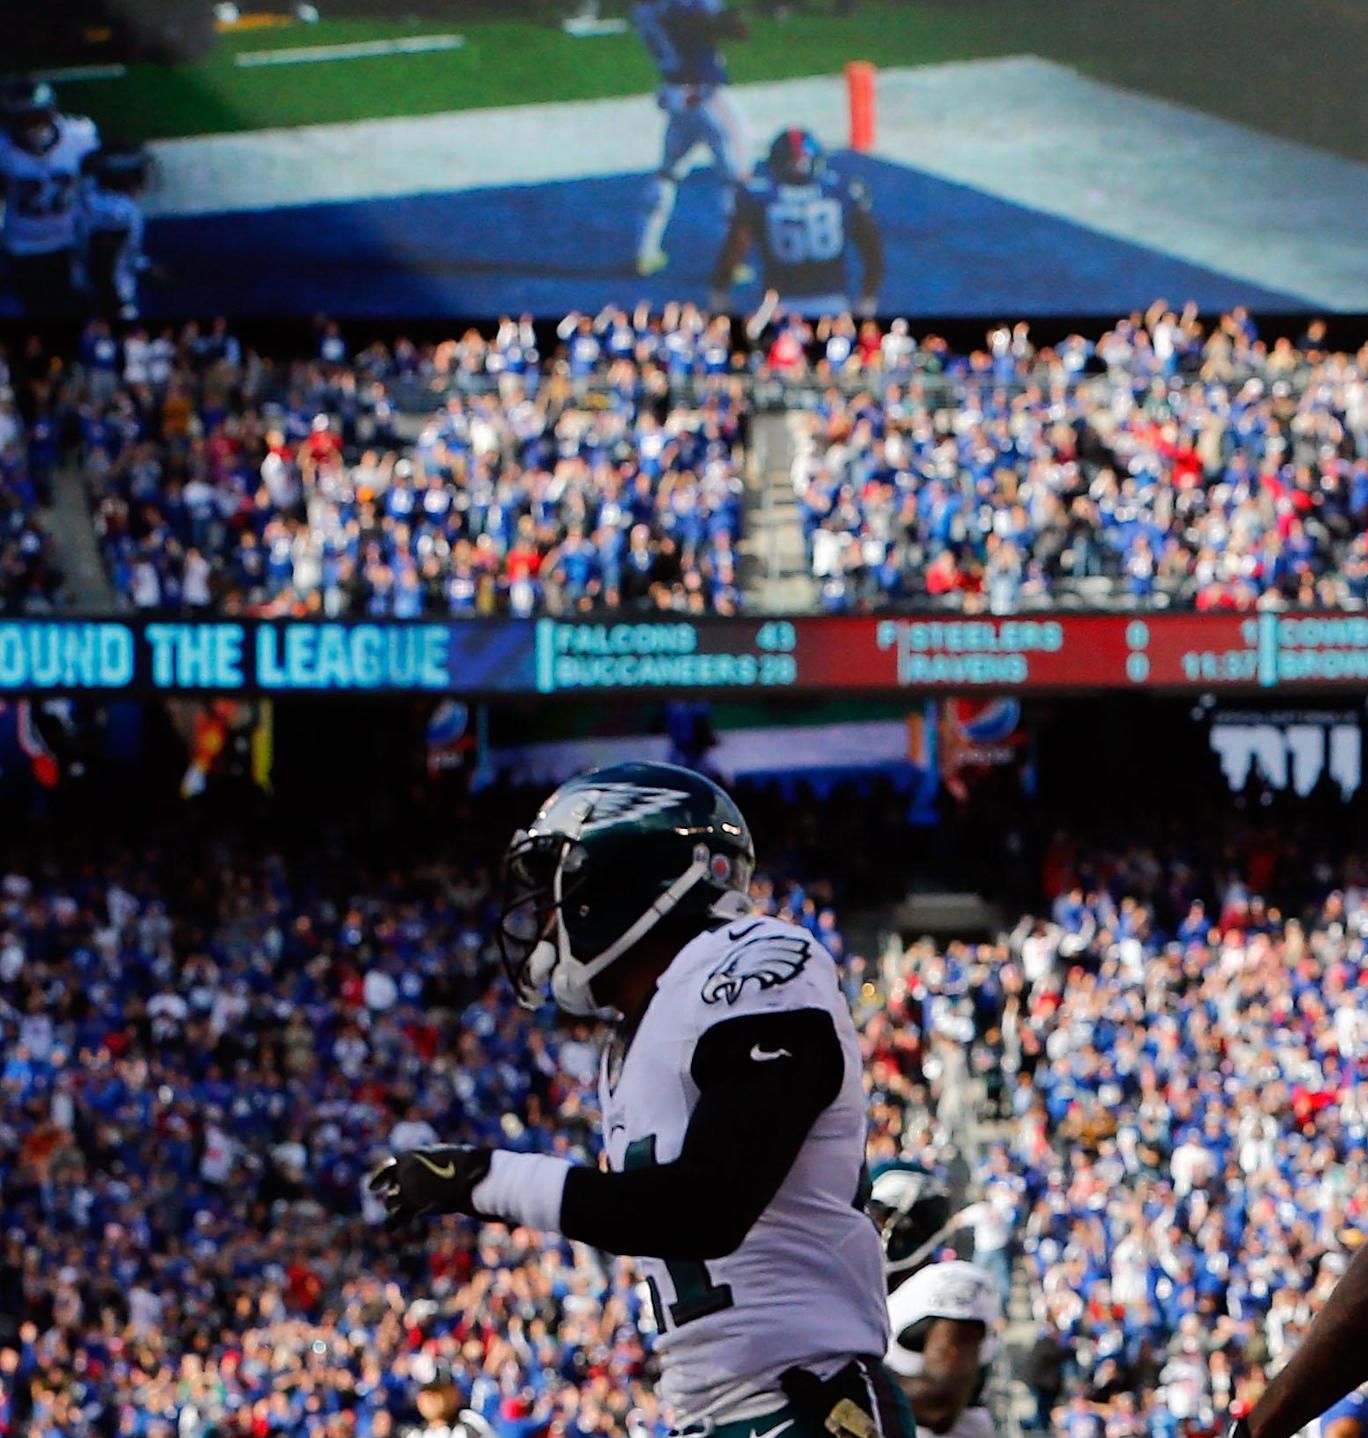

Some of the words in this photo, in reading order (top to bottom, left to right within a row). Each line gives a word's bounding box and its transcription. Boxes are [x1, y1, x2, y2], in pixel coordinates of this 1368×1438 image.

[556, 622, 697, 652] FALCONS
[908, 621, 1063, 652] STEELERS
[0, 623, 134, 688] OUND
[145, 623, 245, 688] THE
[256, 623, 450, 688] LEAGUE
[556, 654, 757, 685] BUCCANEERS
